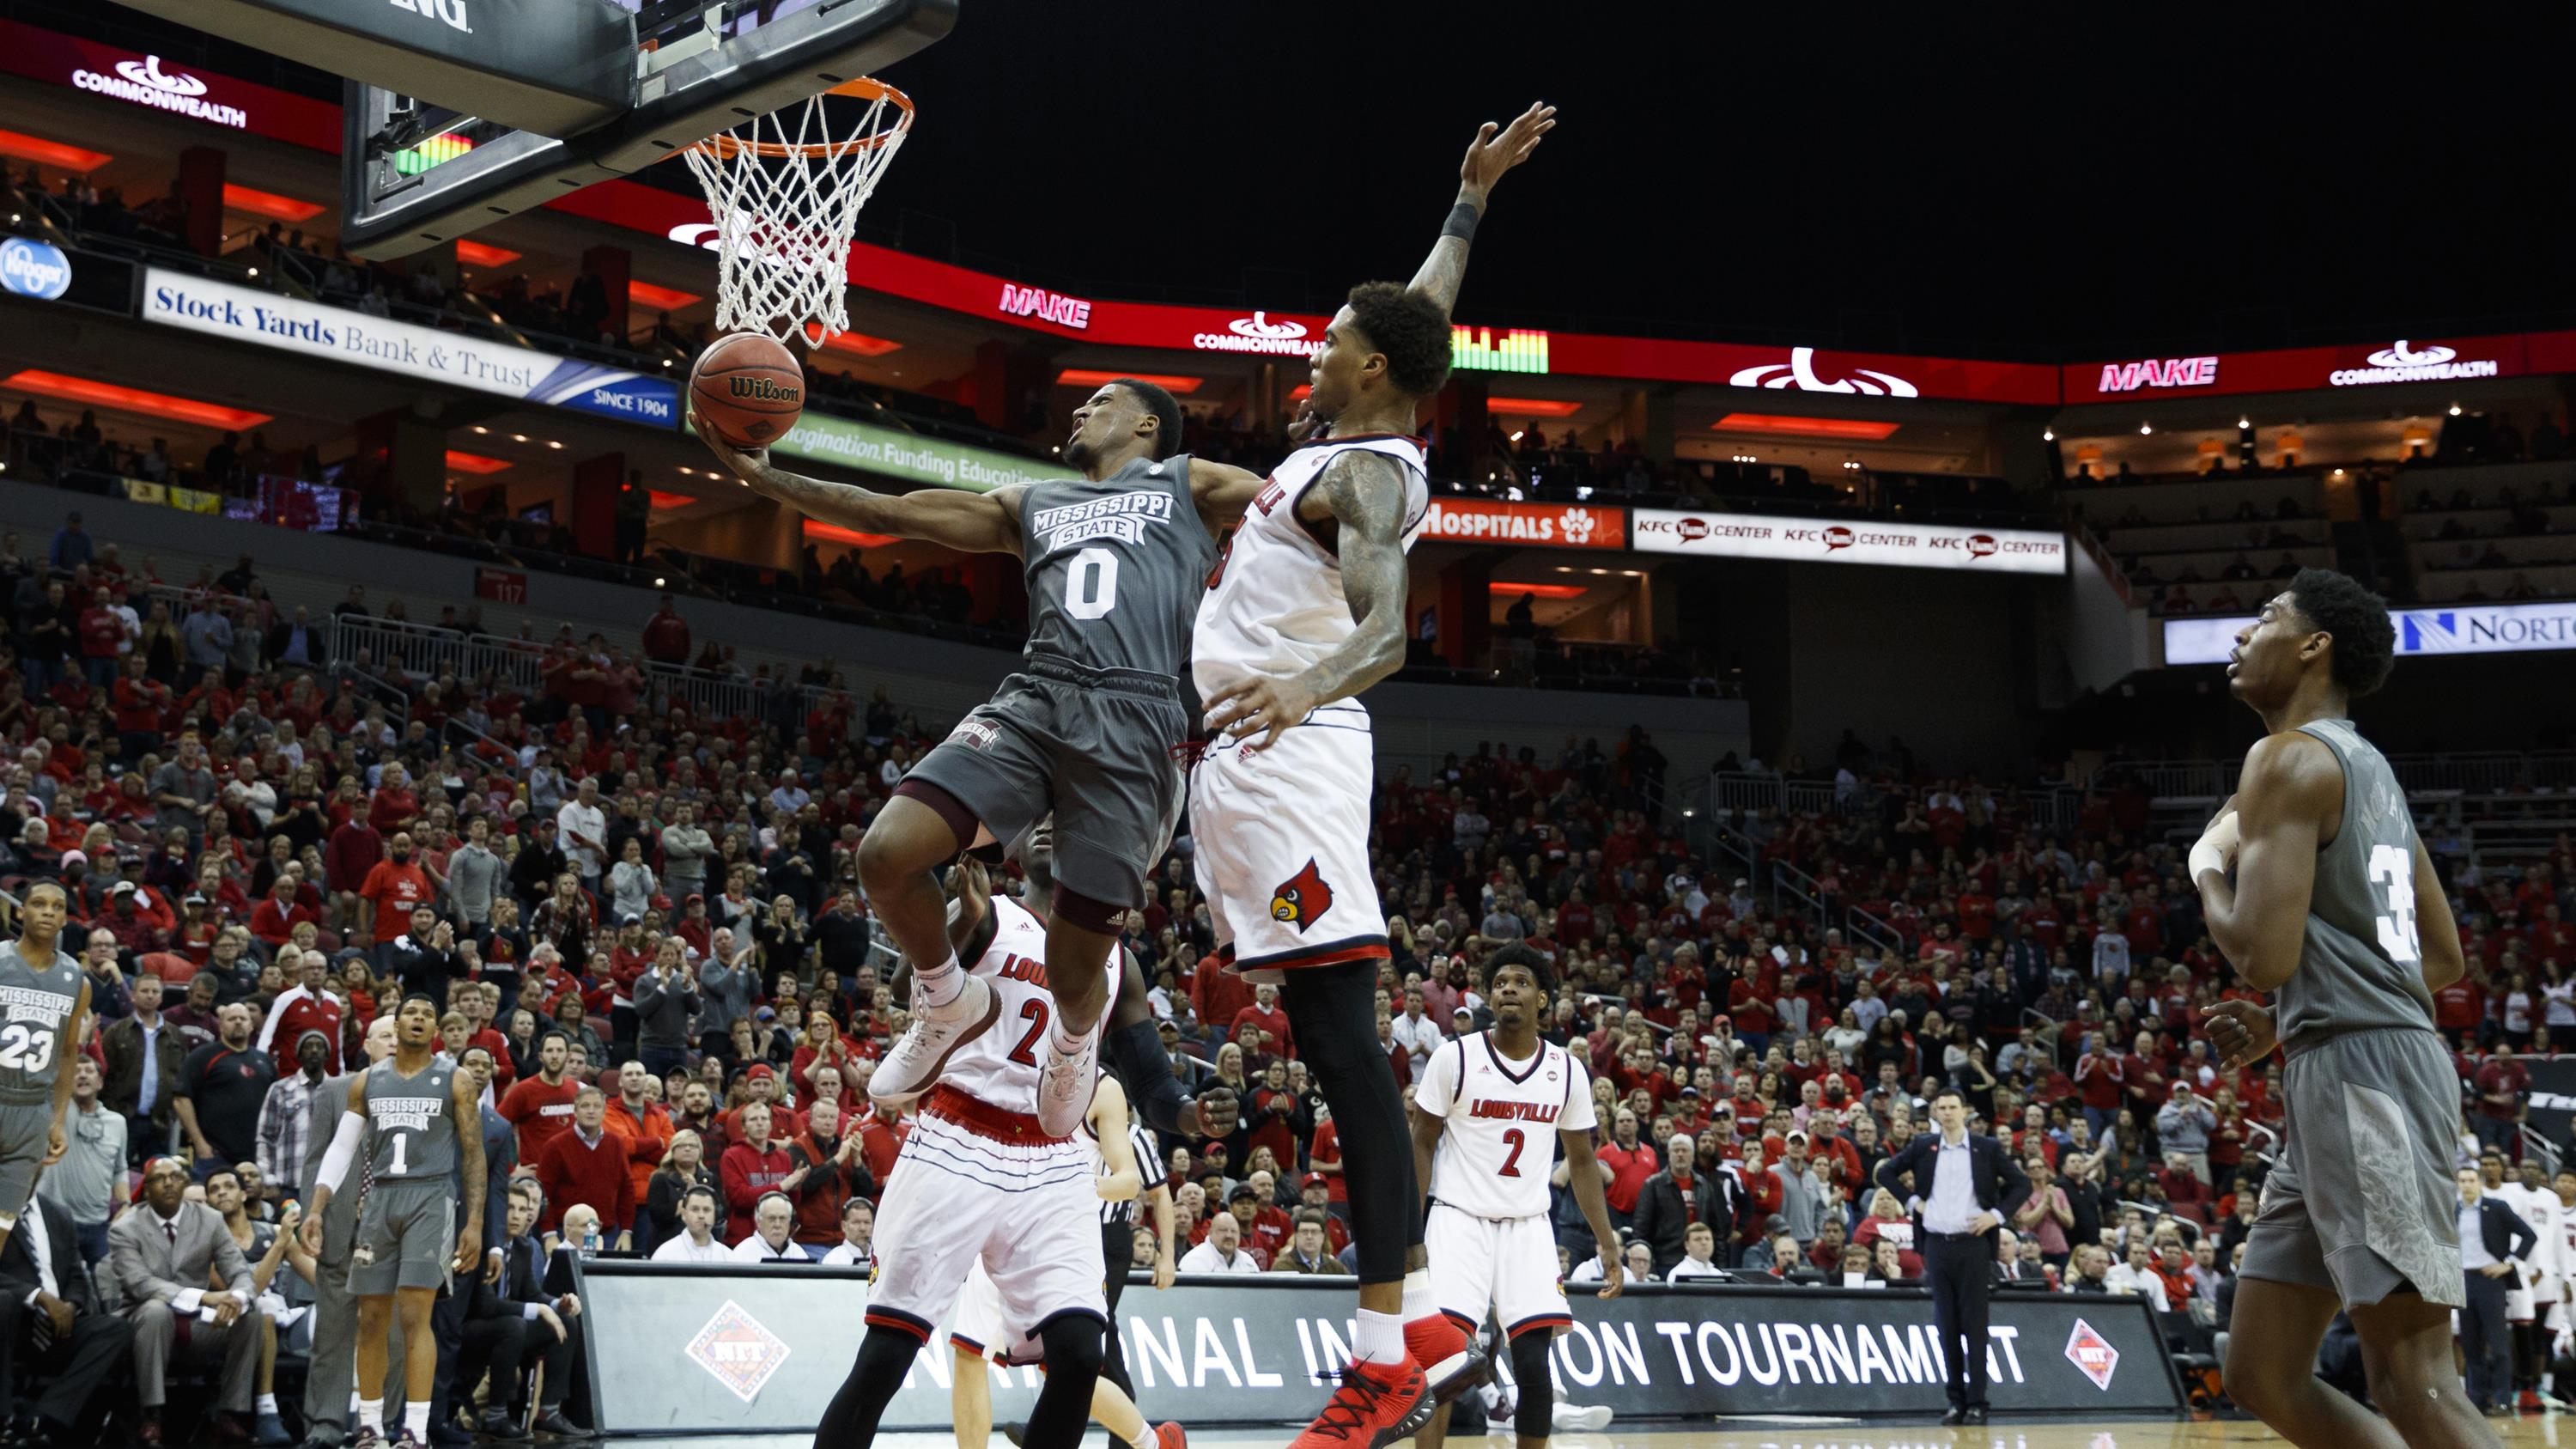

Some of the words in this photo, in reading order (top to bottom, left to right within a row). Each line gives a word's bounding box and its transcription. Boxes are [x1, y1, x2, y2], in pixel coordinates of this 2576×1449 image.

[73, 70, 246, 128] COMMONWEALTH
[5, 246, 63, 292] Kroger
[999, 283, 1091, 329] MAKE
[155, 287, 243, 326] Stock
[254, 307, 336, 345] Yards
[345, 326, 418, 364] Bank
[428, 345, 448, 370] &
[458, 351, 534, 387] Trust
[1194, 333, 1326, 355] COMMONWEAL
[729, 376, 799, 402] Wilson
[2099, 356, 2218, 392] MAKE
[2330, 361, 2497, 386] COMMONWEALTH
[594, 389, 634, 411] SINCE
[637, 399, 668, 417] 1904
[884, 442, 955, 483] Funding
[1033, 495, 1174, 534] MISSISSIPPI
[1063, 521, 1127, 544] STATE
[1638, 521, 1673, 533] KFC
[1714, 525, 1772, 539] CENTER
[1784, 529, 1819, 542] KFC
[1859, 533, 1917, 547] CENTER
[1929, 537, 1962, 551] KFC
[2002, 541, 2060, 555] CENTER
[1065, 548, 1119, 619] 0
[2470, 616, 2576, 644] NORT
[0, 1025, 54, 1073] 23
[1006, 997, 1049, 1068] 2
[385, 1116, 419, 1126] STATE
[390, 1133, 407, 1174] 1
[1498, 1128, 1525, 1178] 2
